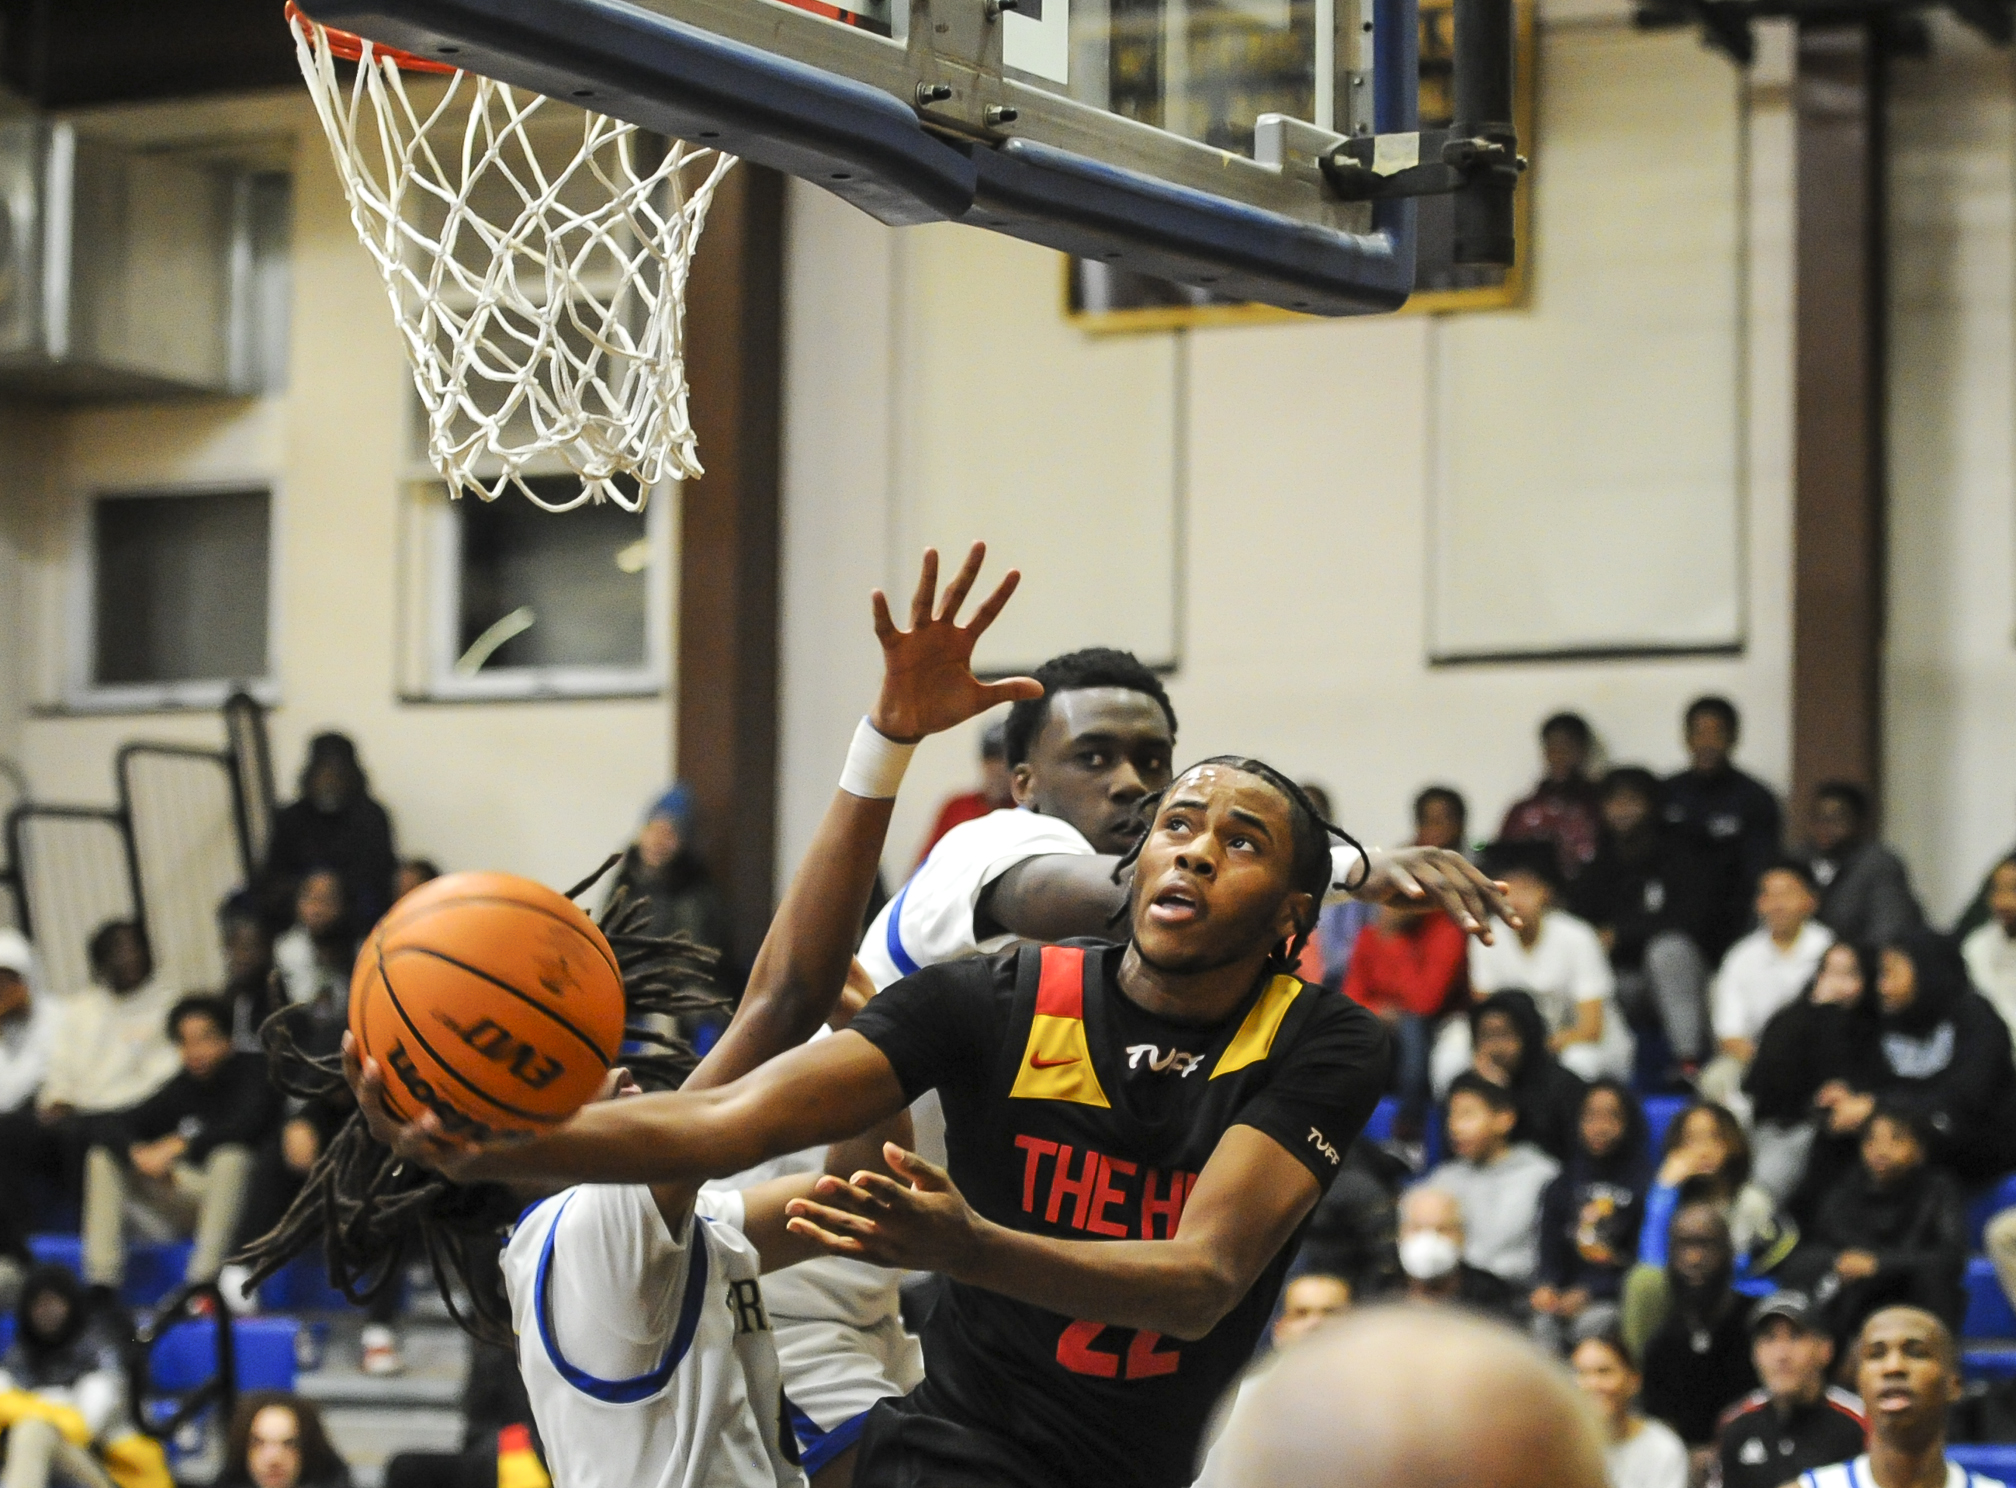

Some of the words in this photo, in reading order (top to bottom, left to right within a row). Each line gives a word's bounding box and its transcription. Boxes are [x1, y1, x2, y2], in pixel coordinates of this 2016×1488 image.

[1125, 1044, 1206, 1078] TUFF
[1307, 1126, 1340, 1165] TUFF
[1014, 1134, 1138, 1238] THE
